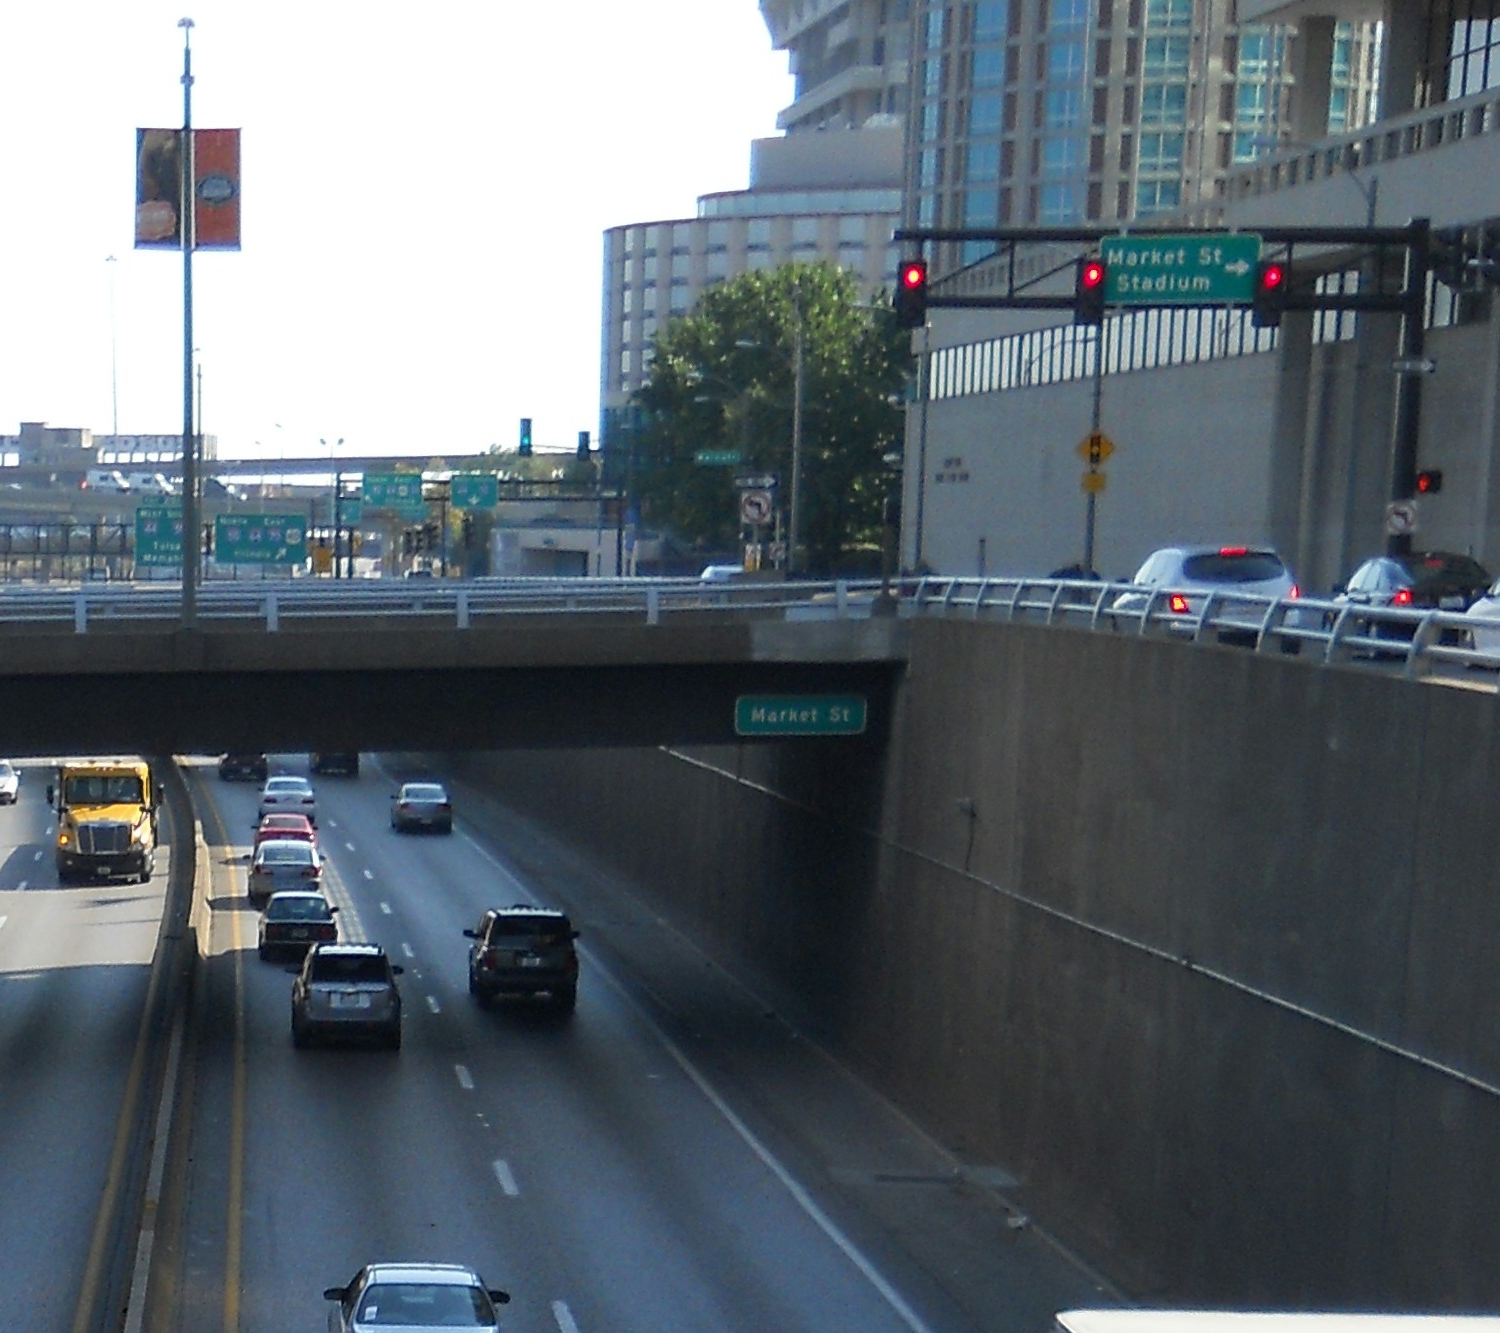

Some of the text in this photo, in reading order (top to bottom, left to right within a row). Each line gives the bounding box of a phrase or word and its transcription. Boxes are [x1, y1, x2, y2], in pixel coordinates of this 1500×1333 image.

[1107, 247, 1222, 266] Market St
[1117, 274, 1210, 292] Stadium
[750, 706, 850, 722] Market St
